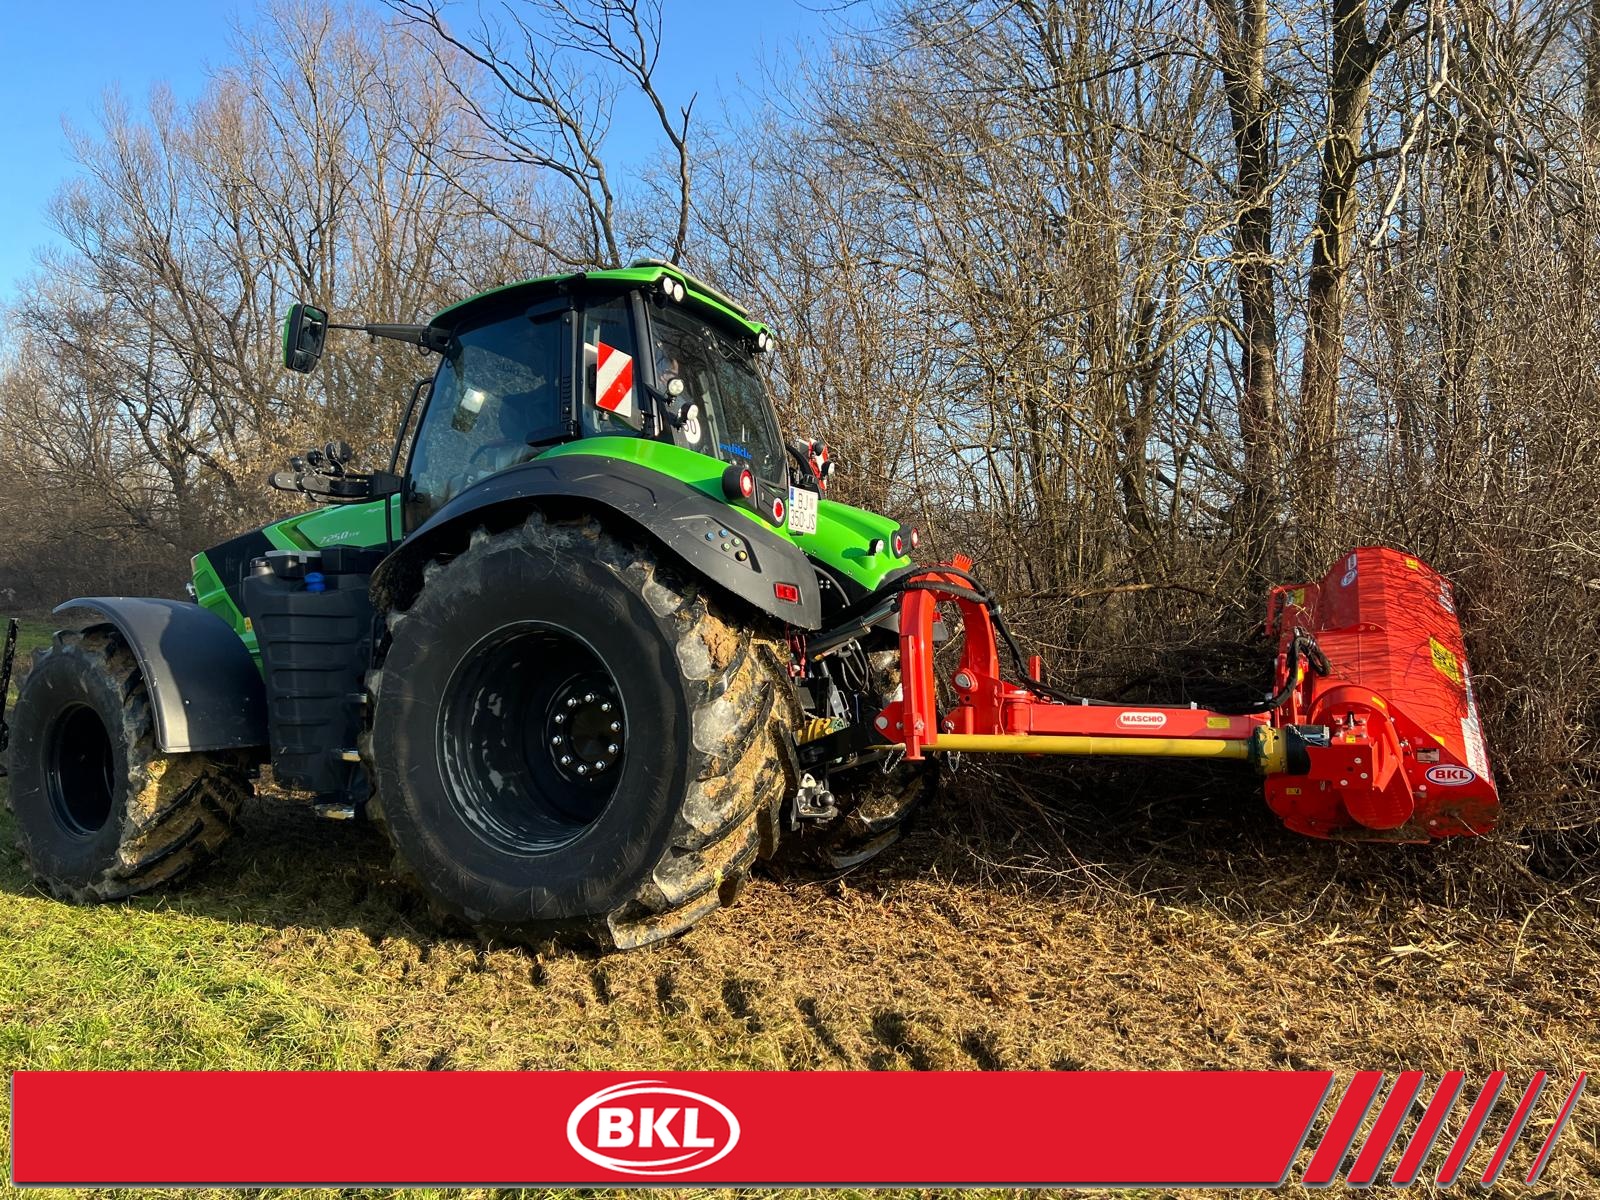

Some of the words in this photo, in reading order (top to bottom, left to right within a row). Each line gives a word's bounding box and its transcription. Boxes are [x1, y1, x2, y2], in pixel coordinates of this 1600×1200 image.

[798, 493, 809, 511] BJ
[1122, 715, 1164, 723] MASCHIO
[1435, 770, 1468, 779] BKL
